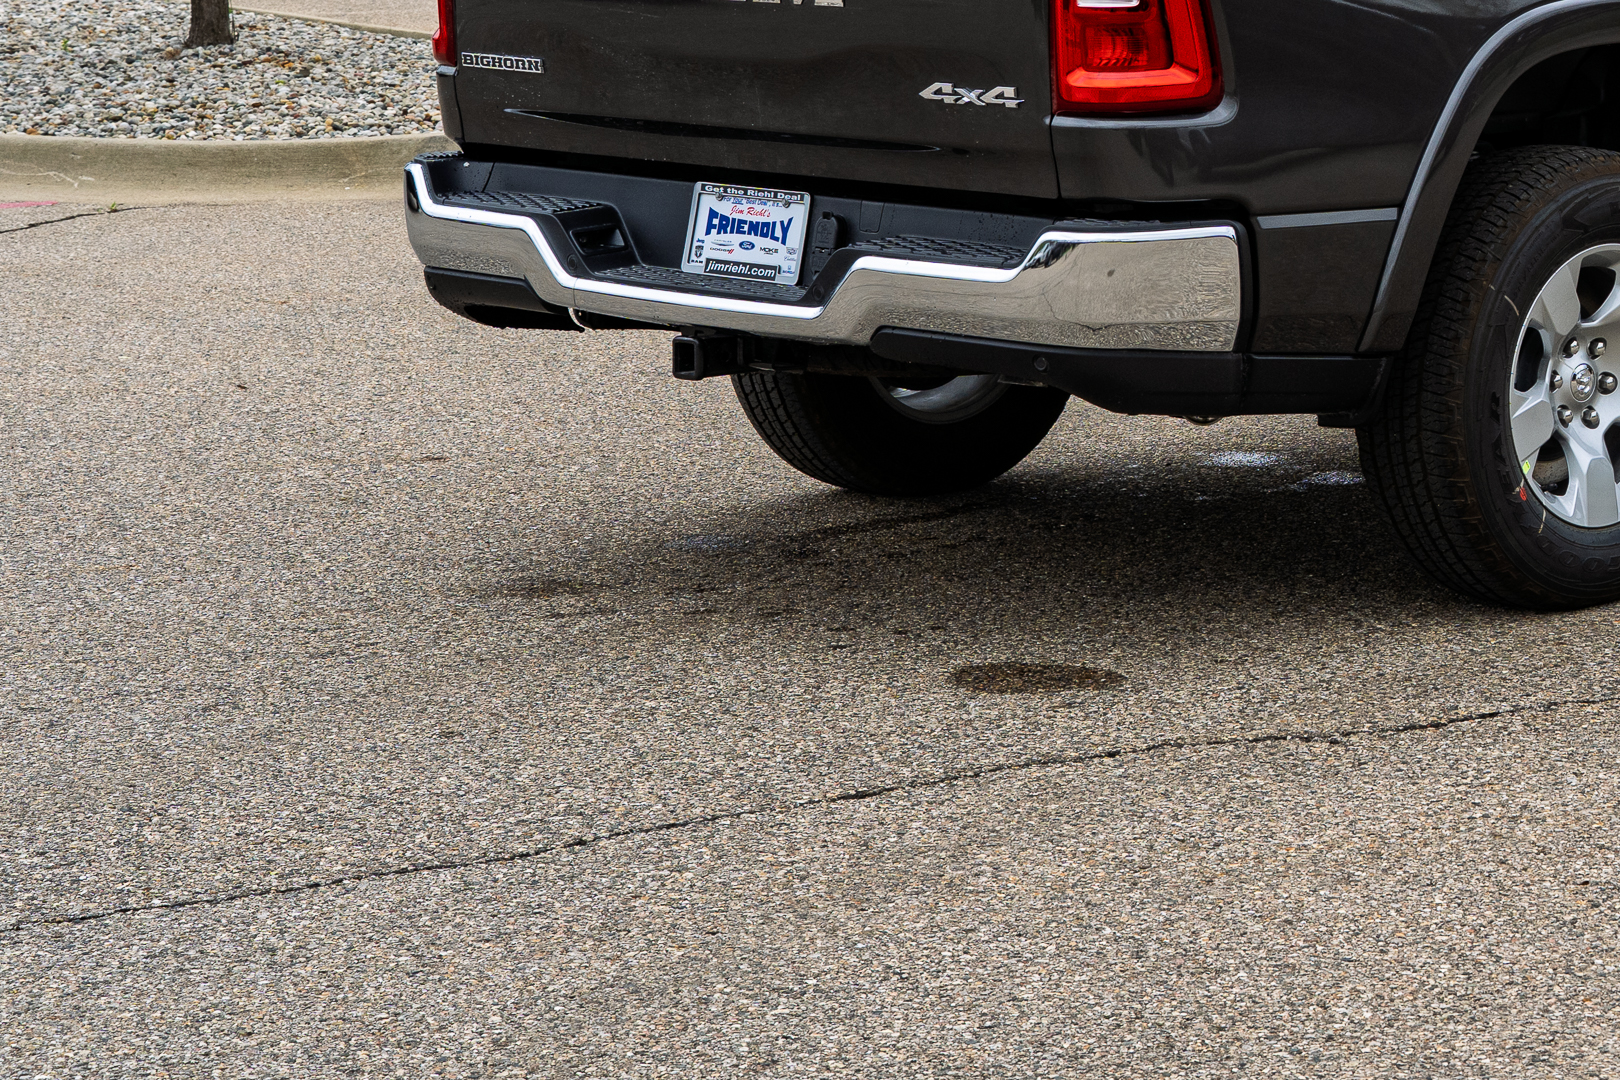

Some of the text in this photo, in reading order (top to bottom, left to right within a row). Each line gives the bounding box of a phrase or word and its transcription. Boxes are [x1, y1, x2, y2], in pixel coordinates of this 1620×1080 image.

[461, 52, 544, 73] BIGHORN
[918, 82, 1025, 109] 4x4
[704, 185, 801, 201] Get the Riehl Deal
[729, 205, 771, 218] Jim Riehl's
[704, 206, 795, 247] FRIENDLY
[705, 260, 775, 277] jimriehl.com
